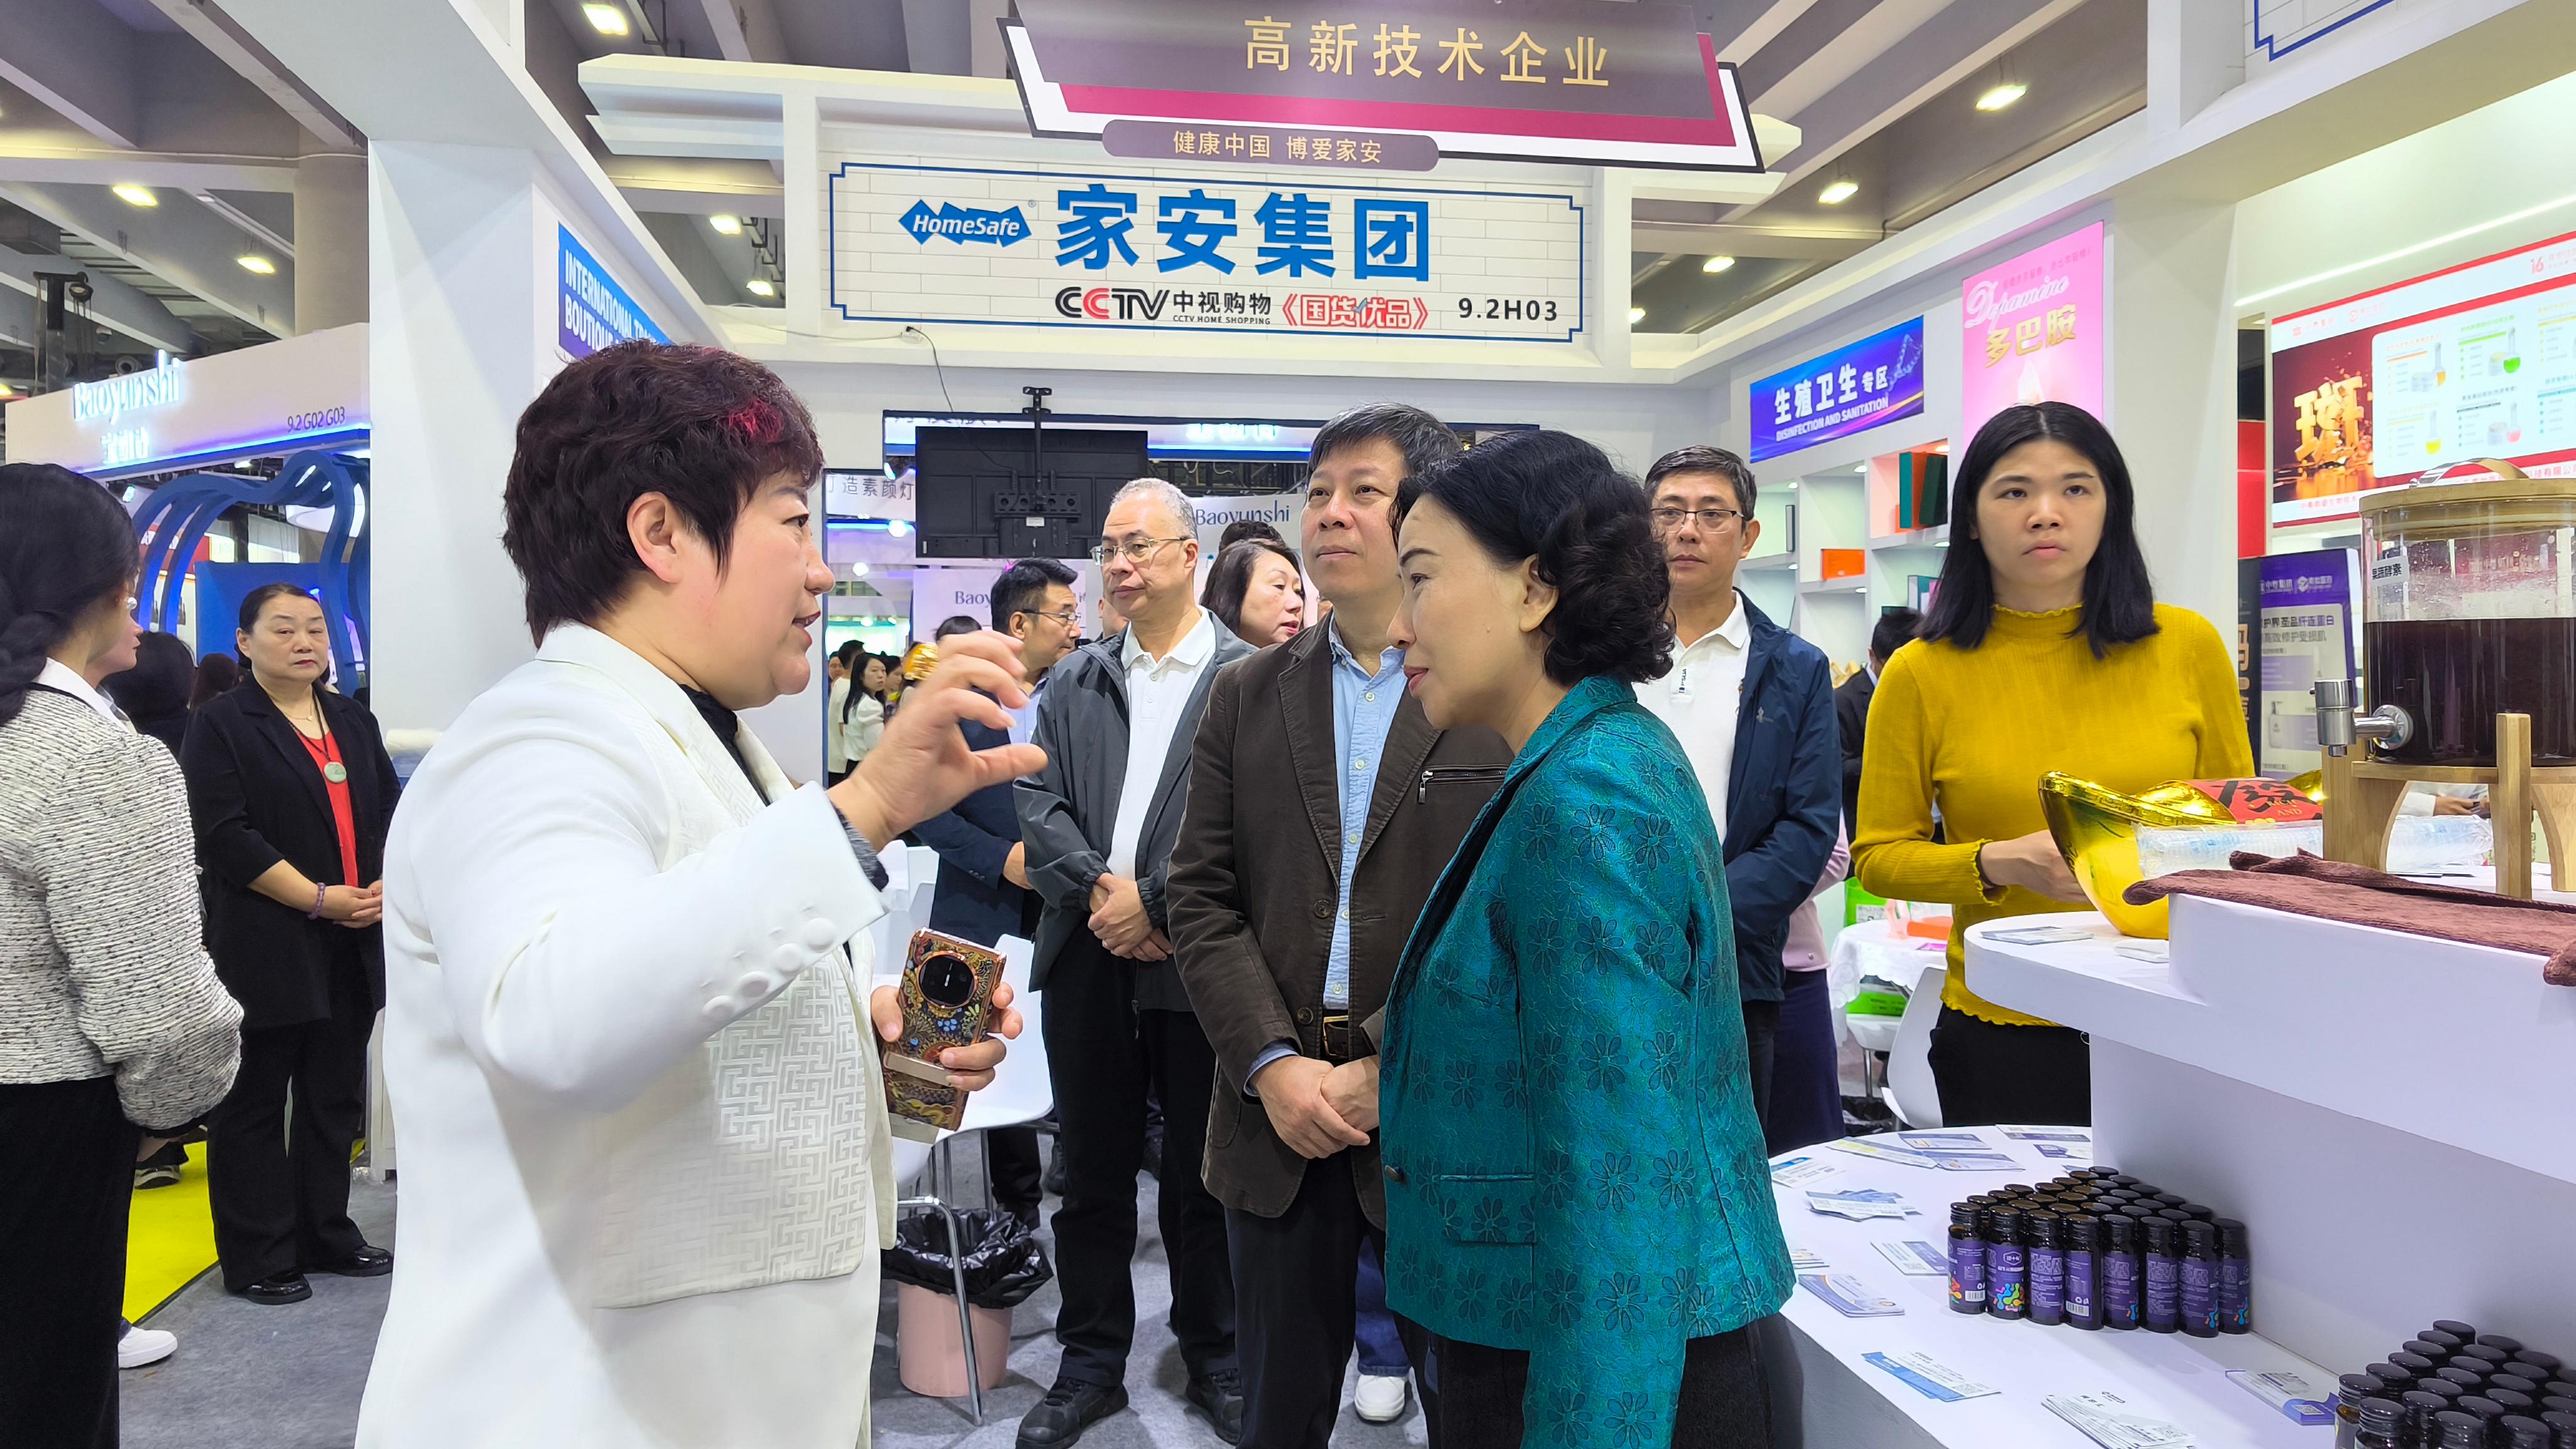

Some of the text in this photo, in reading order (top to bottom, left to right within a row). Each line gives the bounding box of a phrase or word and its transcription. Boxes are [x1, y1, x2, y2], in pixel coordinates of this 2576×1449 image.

[1243, 15, 1609, 87] 高新技术企业
[1173, 130, 1382, 164] 健康中国 博爱家安
[912, 214, 1020, 237] HomeSafe
[1054, 183, 1430, 282] 家安集团
[565, 248, 633, 339] INTERNATIONAL
[1055, 286, 1429, 330] CCTV 中视购物 《国货优品》
[1458, 297, 1558, 321] 9.2H03
[1172, 314, 1271, 325] CCTV HOME SHOPPING
[1985, 303, 2077, 369] 多巴胺
[73, 349, 181, 426] Baoyunshi
[287, 406, 346, 433] 9.2 G02 G03
[1775, 396, 1889, 442] DISINFECTION AND SANITATION
[1195, 499, 1290, 526] Baoyunshi
[2277, 808, 2303, 816] AND
